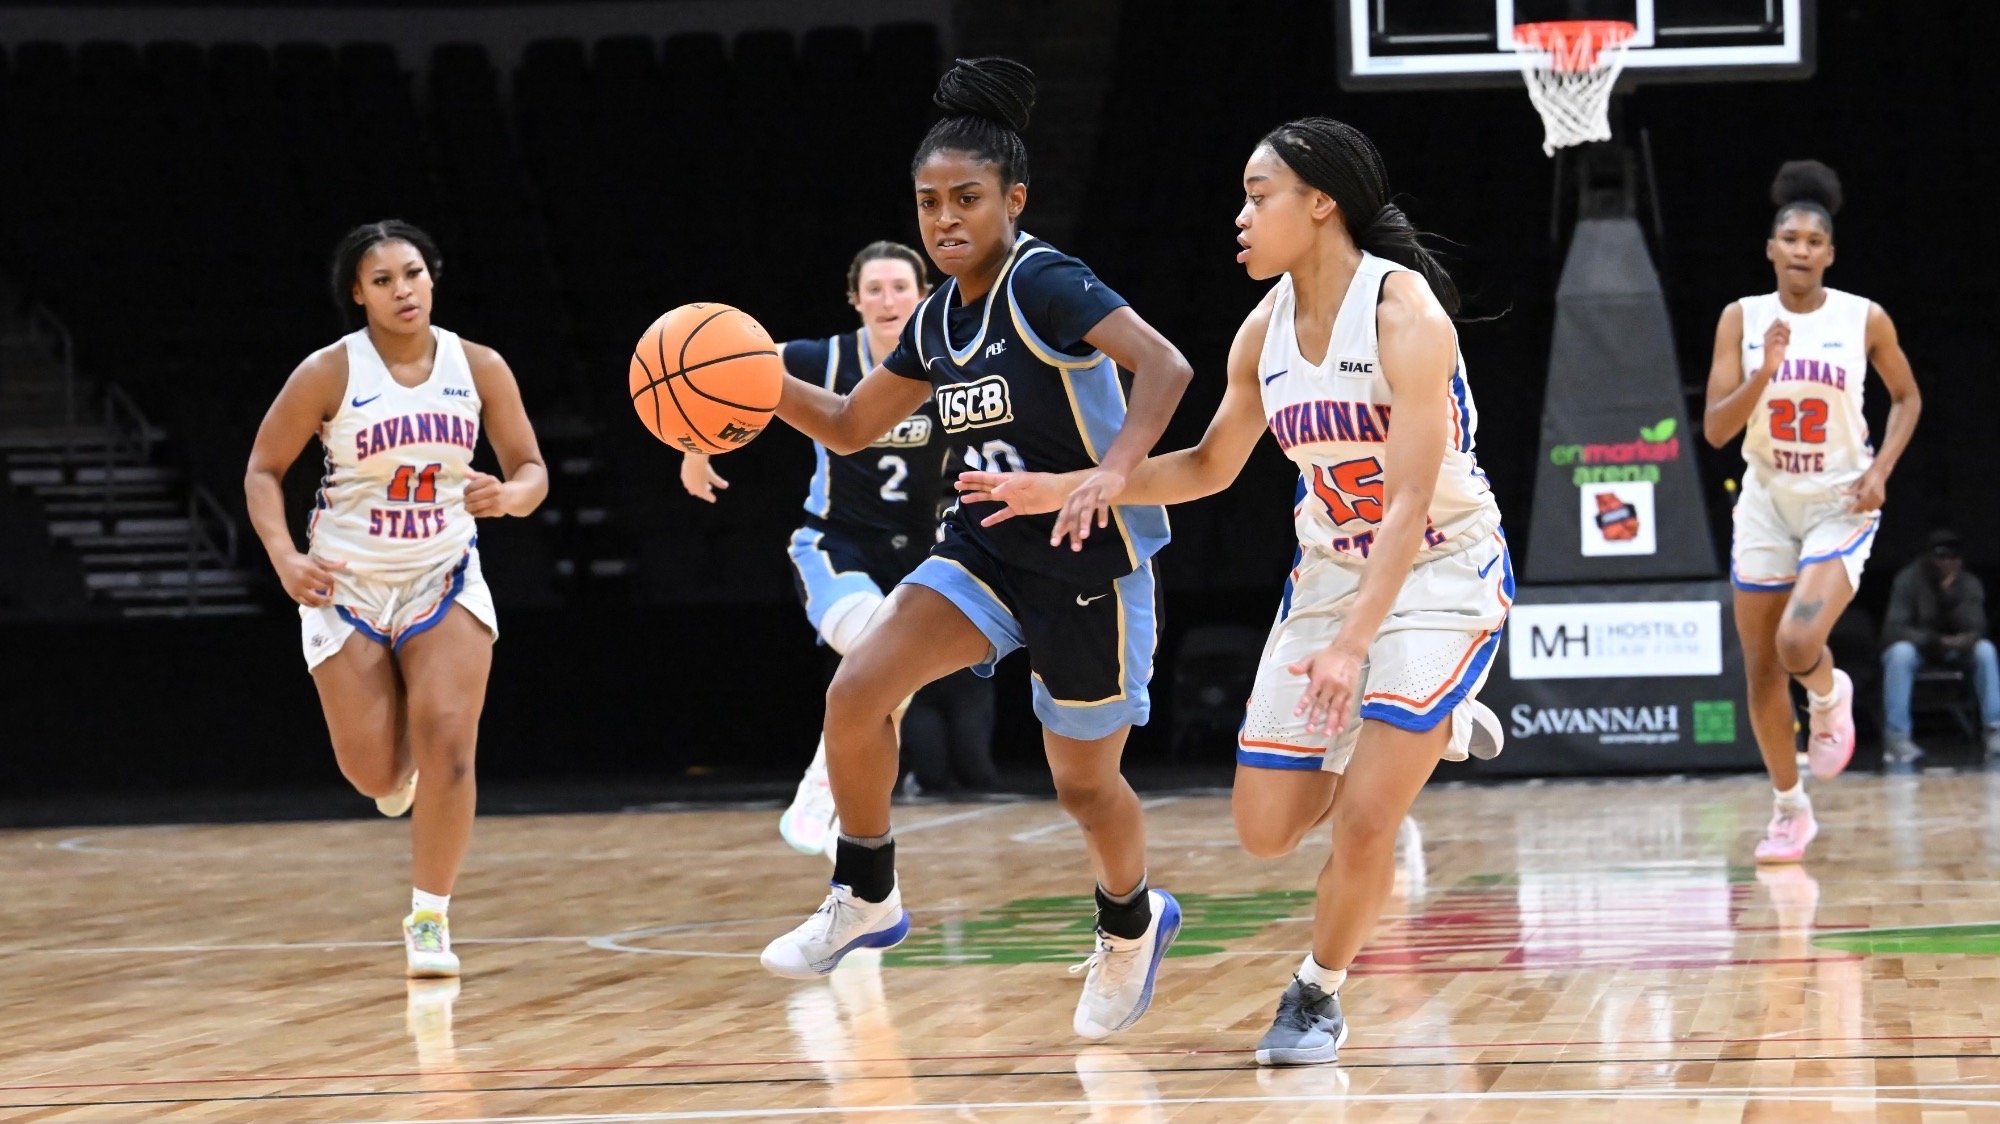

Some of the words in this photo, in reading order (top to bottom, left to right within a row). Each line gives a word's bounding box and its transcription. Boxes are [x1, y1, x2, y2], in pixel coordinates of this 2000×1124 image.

[1339, 361, 1373, 373] SIAC
[1750, 359, 1846, 392] ANNAH
[442, 387, 470, 398] SIAC
[938, 382, 1004, 427] USCB
[355, 413, 475, 461] SAVANNAH
[1269, 399, 1391, 452] AVANNA
[1768, 398, 1828, 444] 22
[877, 455, 908, 501] 2
[1774, 450, 1824, 474] STATE
[387, 463, 442, 503] 11
[1312, 456, 1384, 526] 15
[369, 508, 446, 538] STATE
[1511, 703, 1679, 739] SAVANNAH
